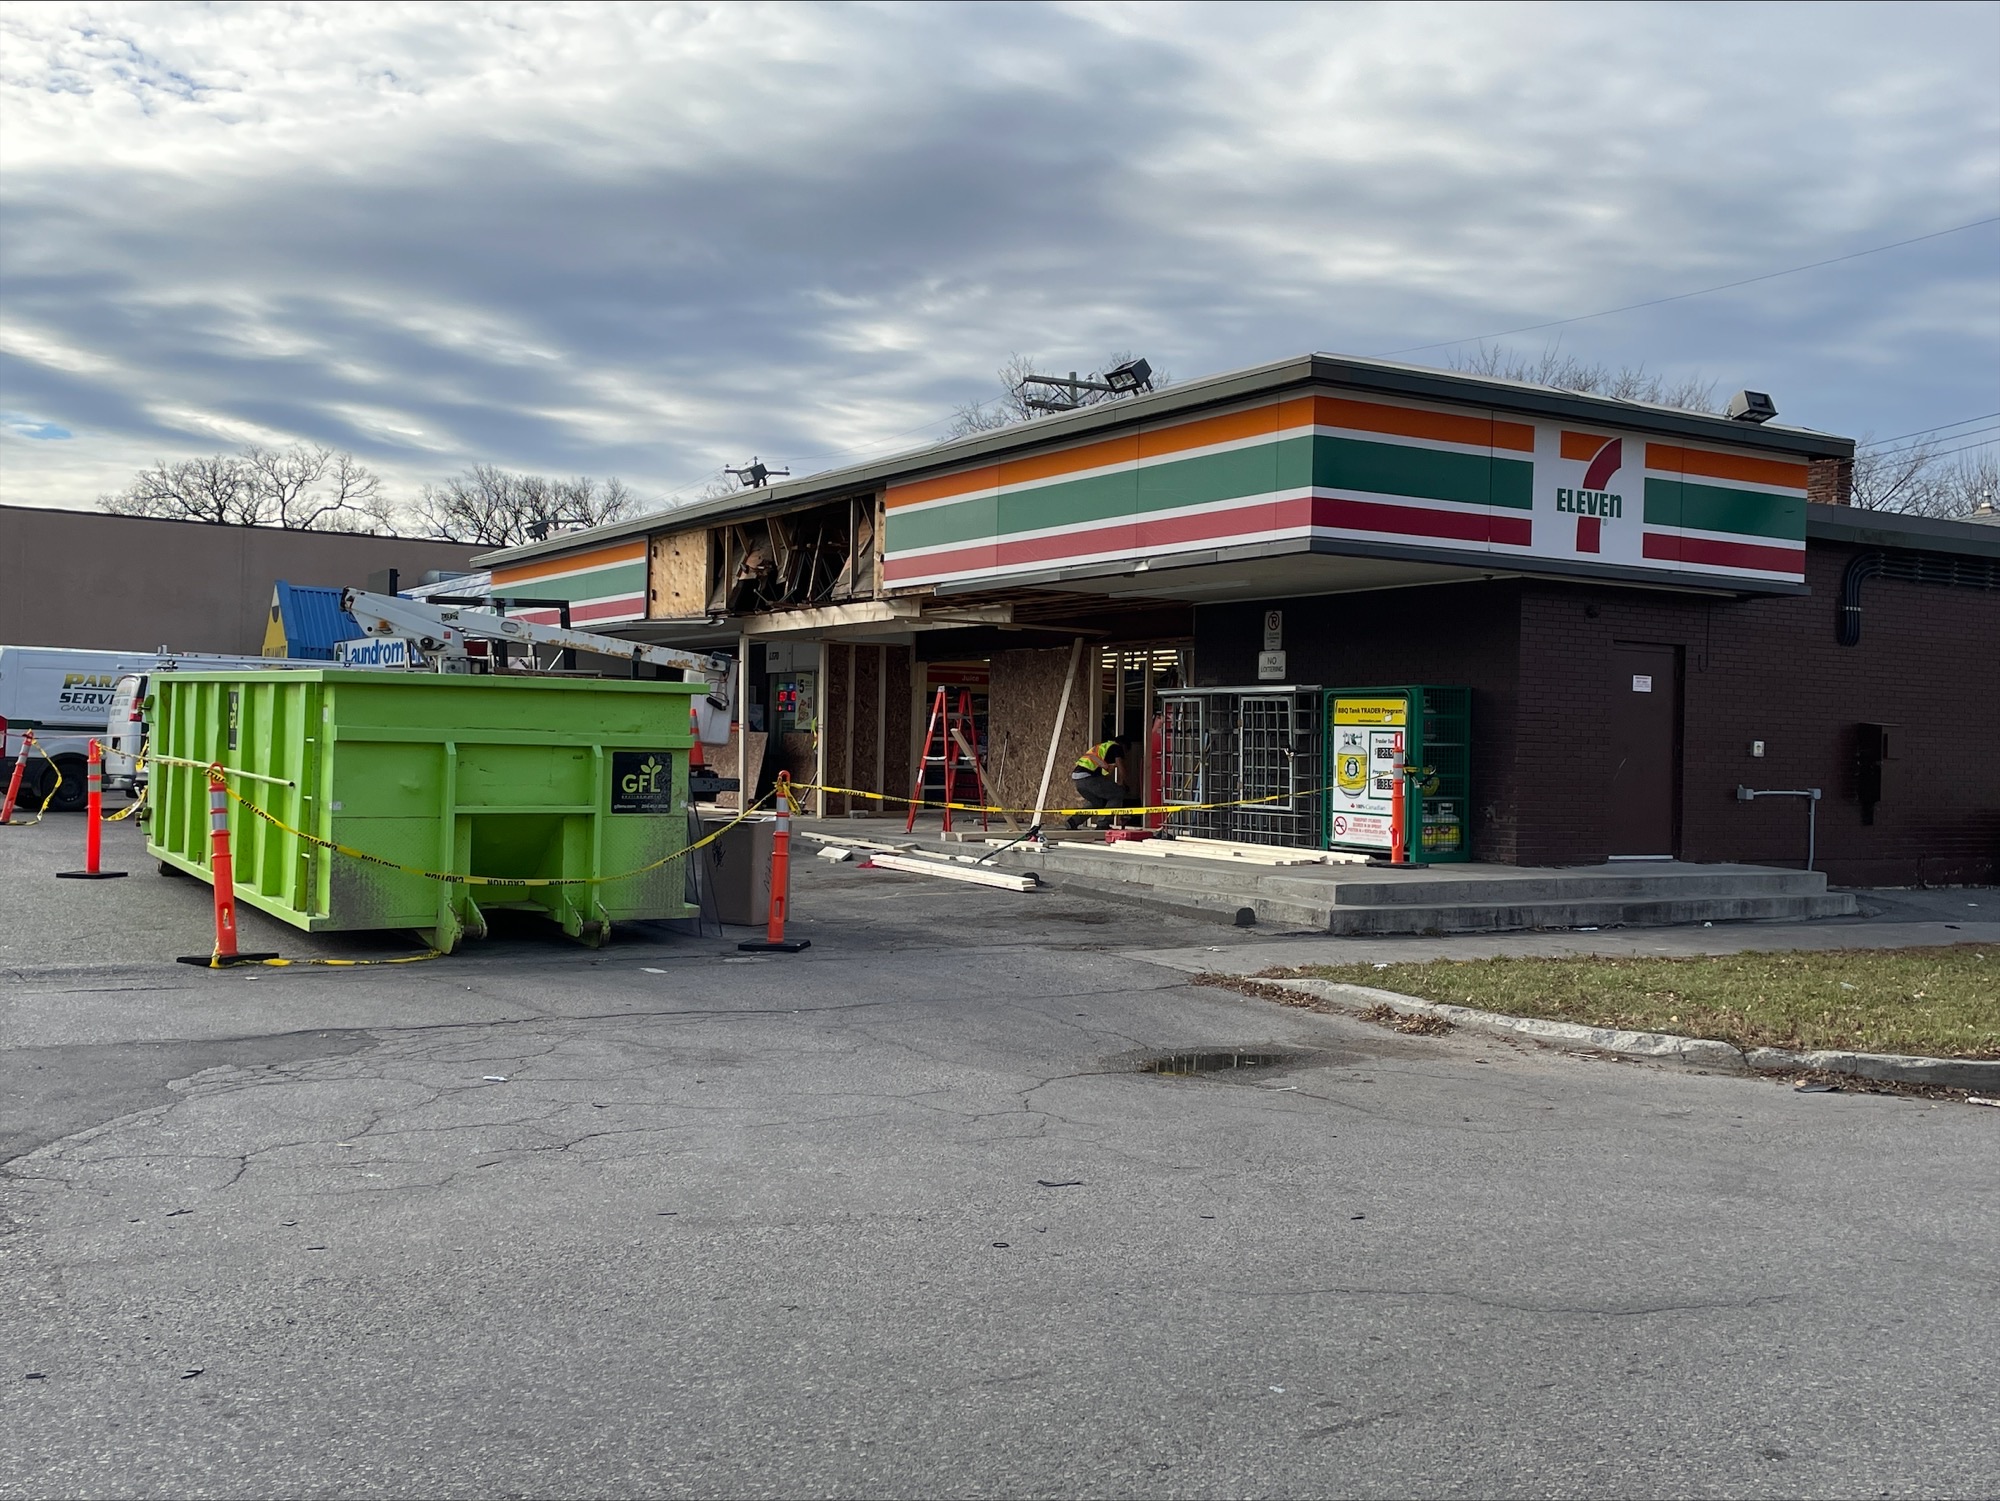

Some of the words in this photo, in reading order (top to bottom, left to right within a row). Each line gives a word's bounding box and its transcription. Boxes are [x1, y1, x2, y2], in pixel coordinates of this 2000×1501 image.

[1560, 430, 1622, 554] 7
[345, 639, 421, 665] Laundrom
[1267, 656, 1277, 665] NO
[1260, 665, 1283, 673] LOITERING
[961, 674, 980, 682] Juice
[59, 692, 115, 705] SERVI
[60, 704, 105, 713] CANADA
[1381, 707, 1403, 716] Program
[622, 765, 661, 793] GFL
